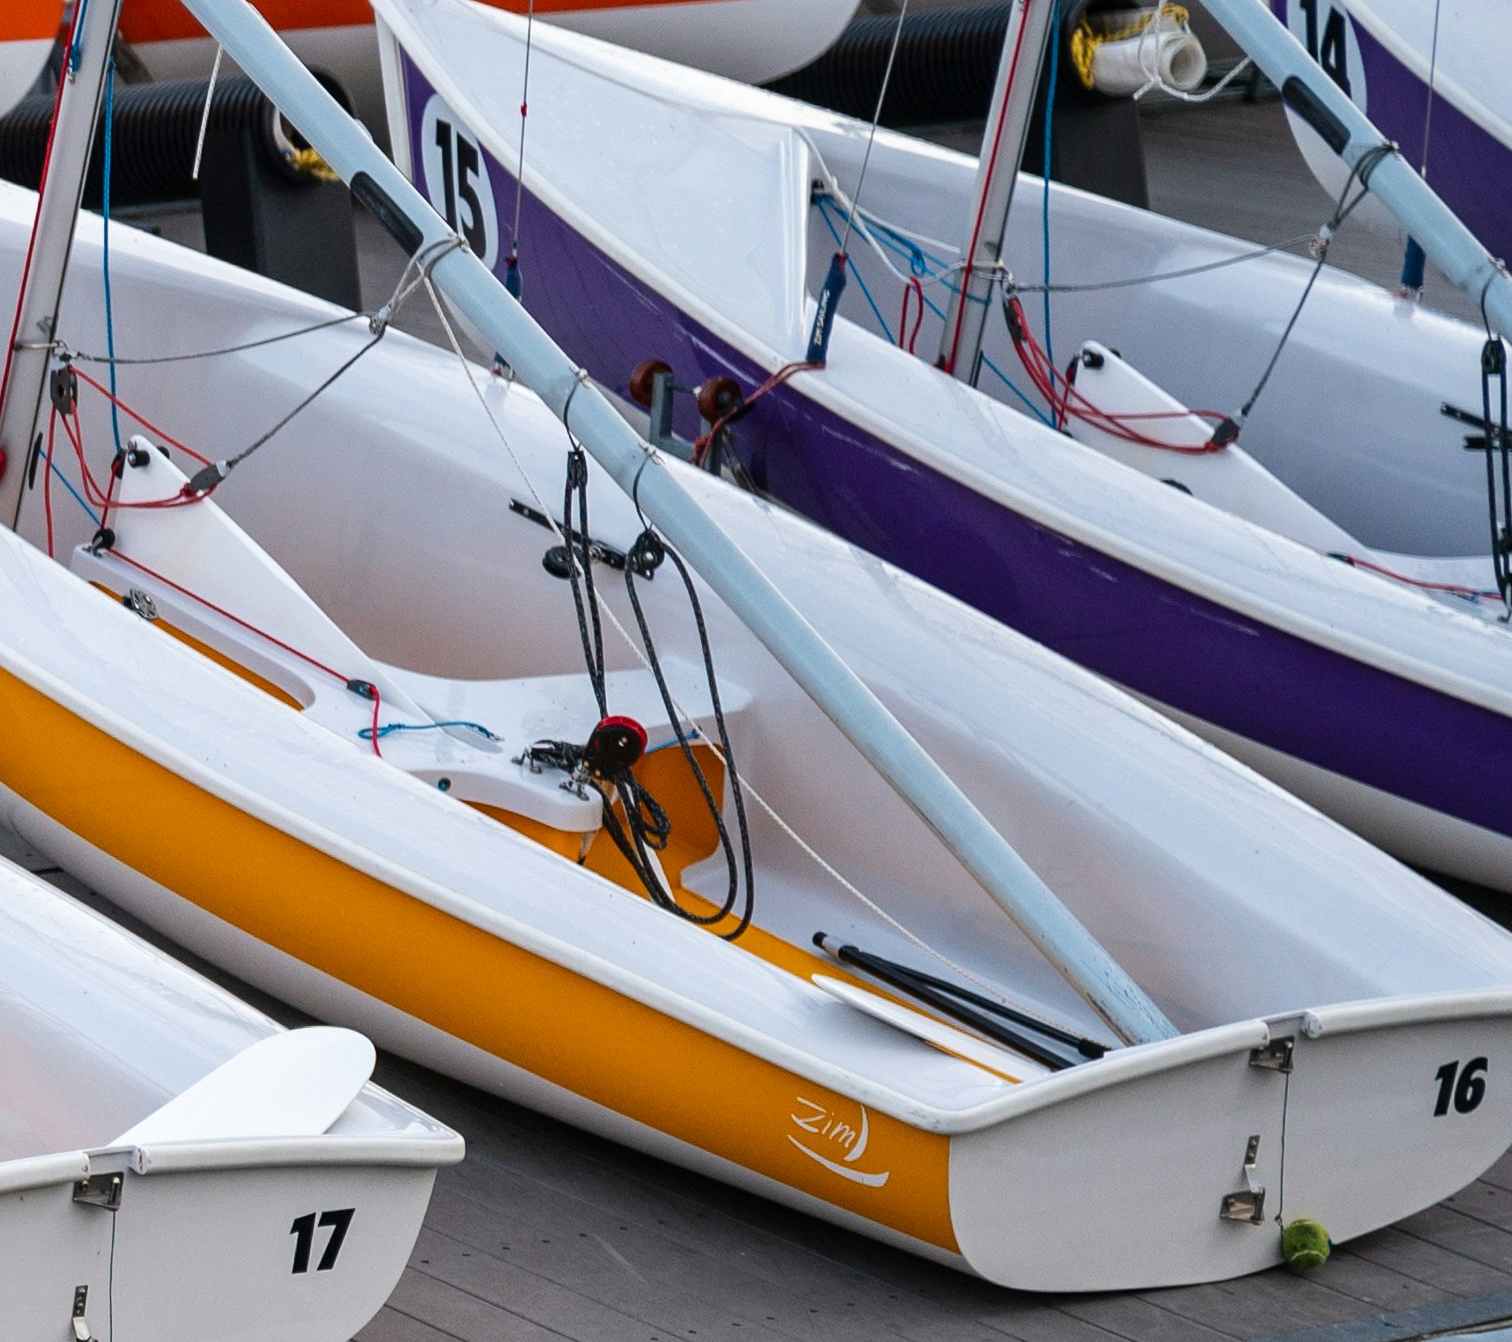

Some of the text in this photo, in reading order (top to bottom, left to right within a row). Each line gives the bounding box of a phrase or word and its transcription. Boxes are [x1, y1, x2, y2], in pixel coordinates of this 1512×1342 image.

[435, 118, 487, 260] 15
[1433, 1056, 1489, 1117] 16
[790, 1096, 856, 1149] Zim
[289, 1207, 356, 1274] 17
